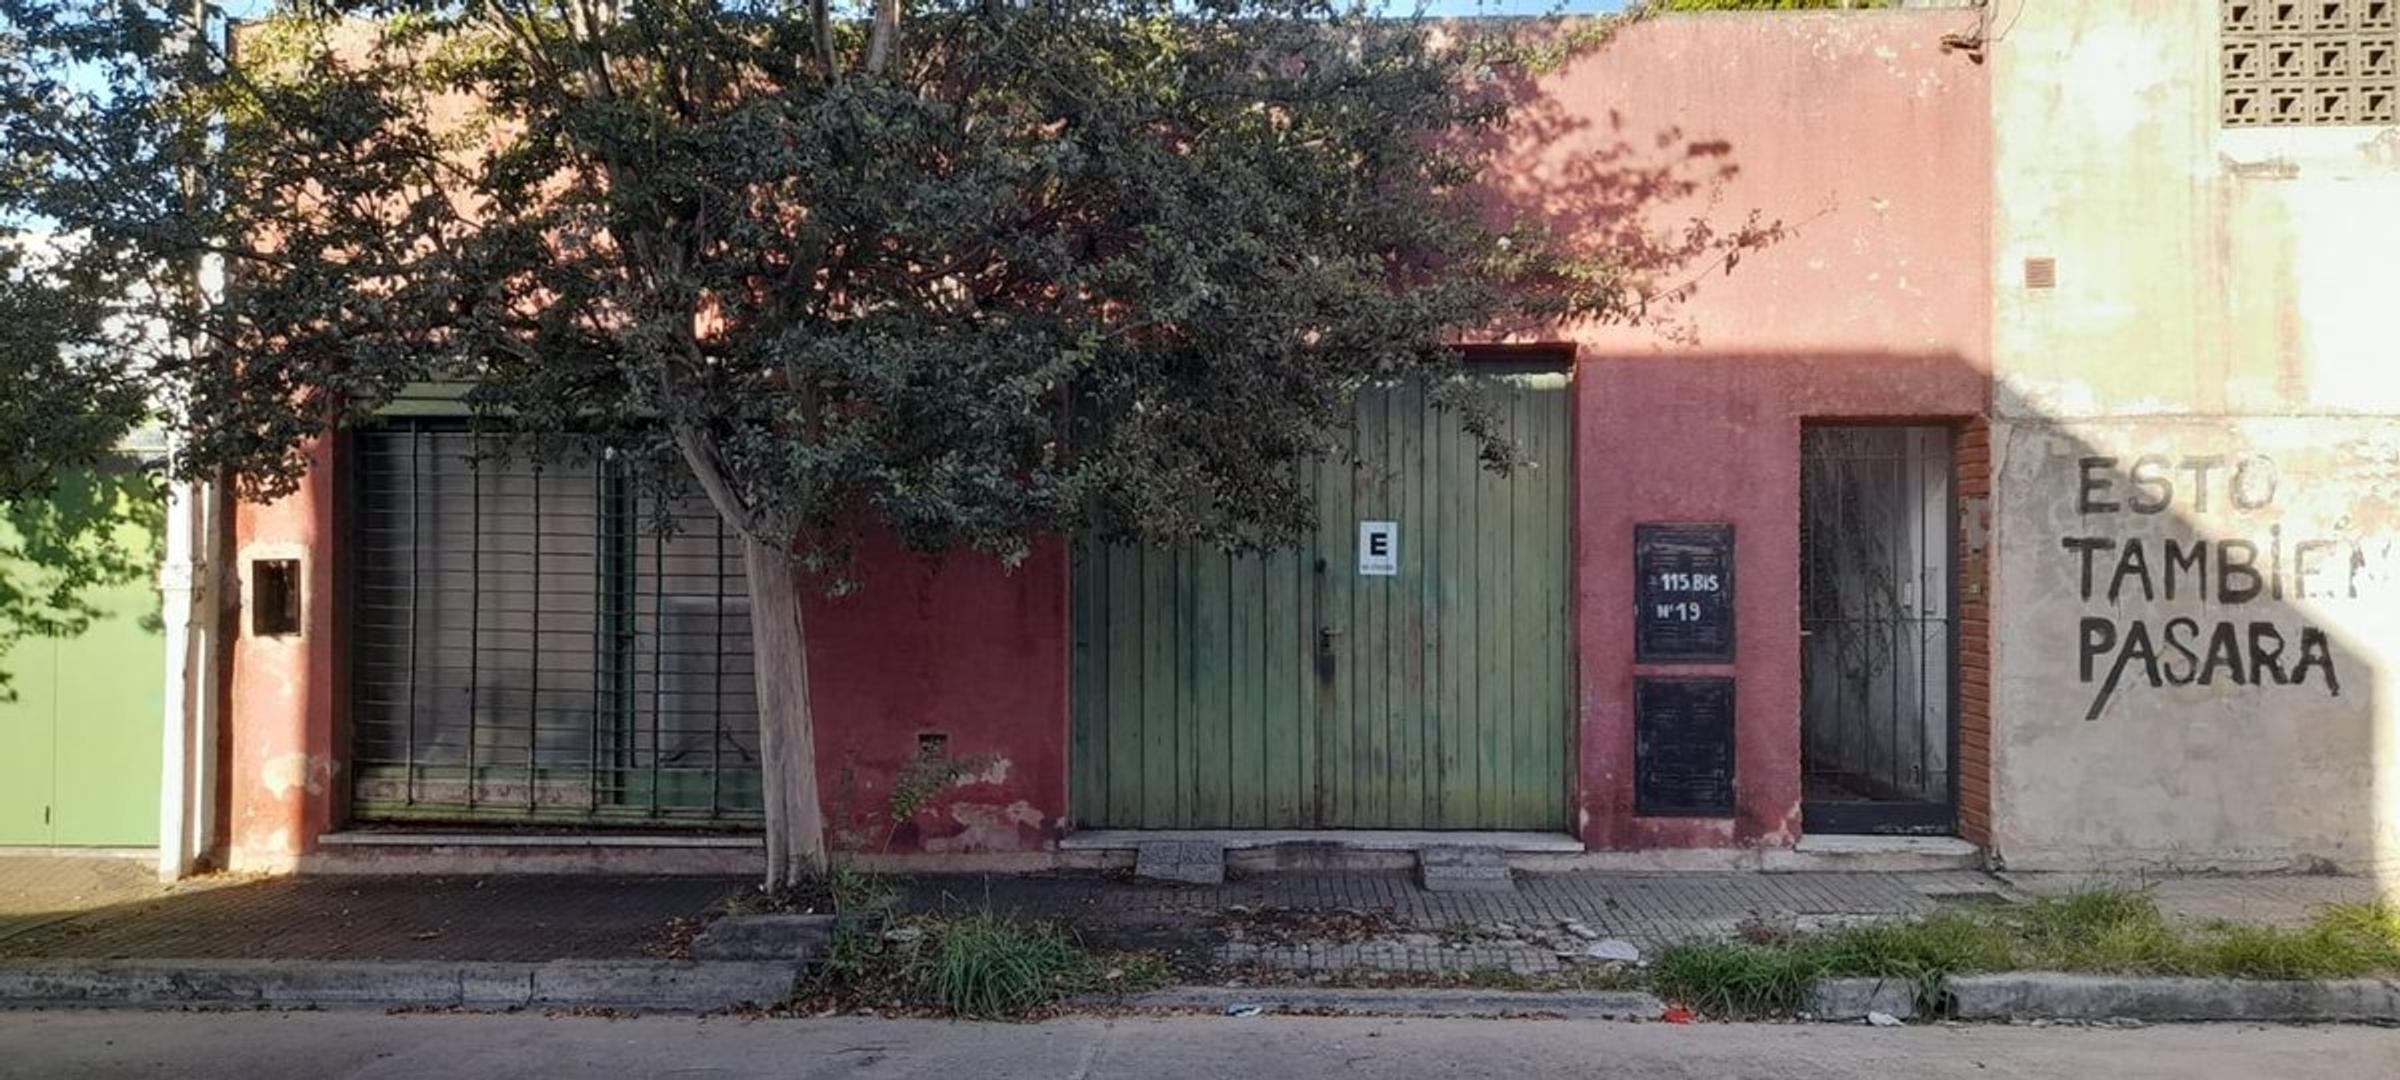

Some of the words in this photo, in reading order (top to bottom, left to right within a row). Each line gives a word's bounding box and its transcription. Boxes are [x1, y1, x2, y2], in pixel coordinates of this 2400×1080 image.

[2078, 455, 2278, 515] ESTO
[1371, 533, 1387, 555] E
[1661, 573, 1690, 591] 115
[1676, 602, 1701, 621] 19
[2079, 615, 2340, 720] PASARA
